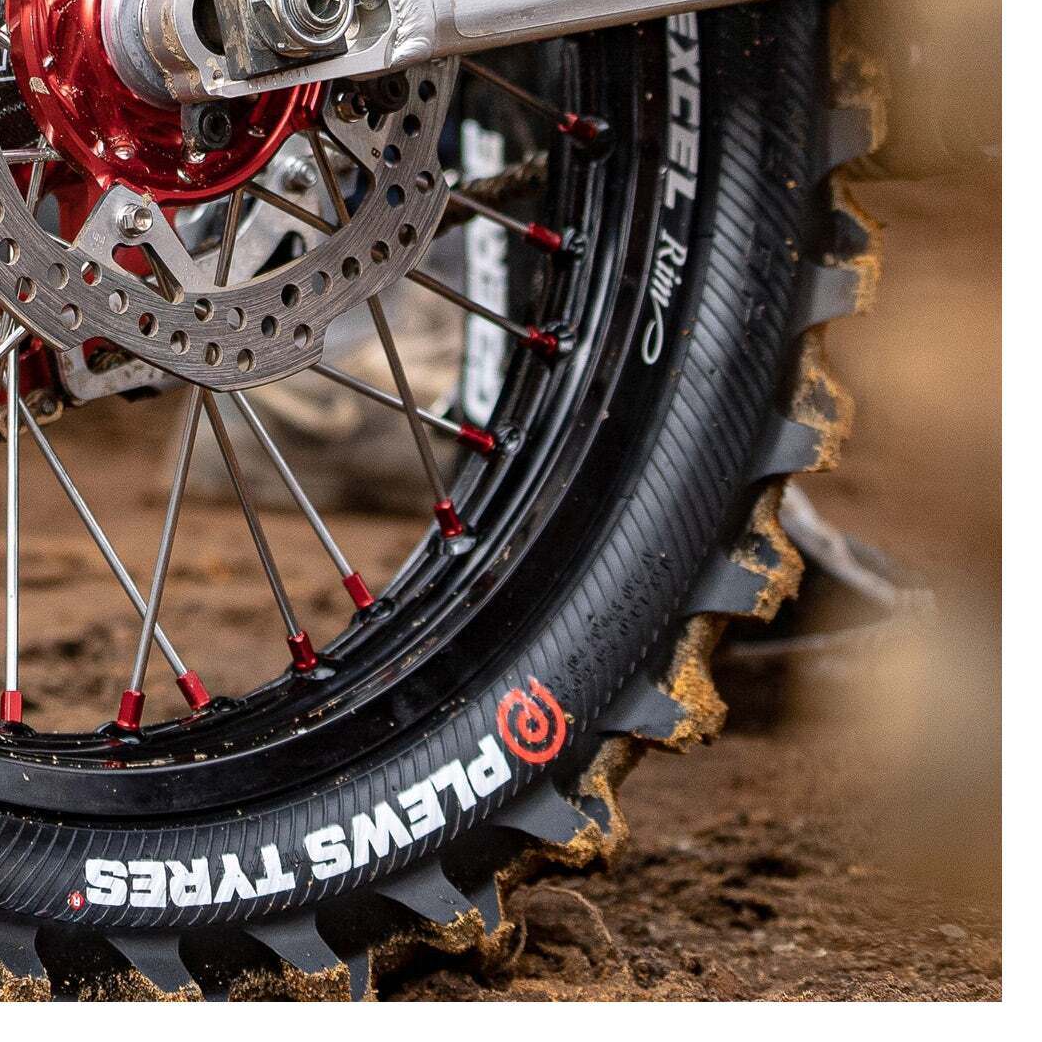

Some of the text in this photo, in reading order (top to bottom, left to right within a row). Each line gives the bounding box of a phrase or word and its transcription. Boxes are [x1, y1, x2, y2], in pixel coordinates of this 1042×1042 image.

[664, 12, 700, 209] EXCEL
[84, 843, 296, 908] TYRES
[304, 734, 513, 880] PLEWS
